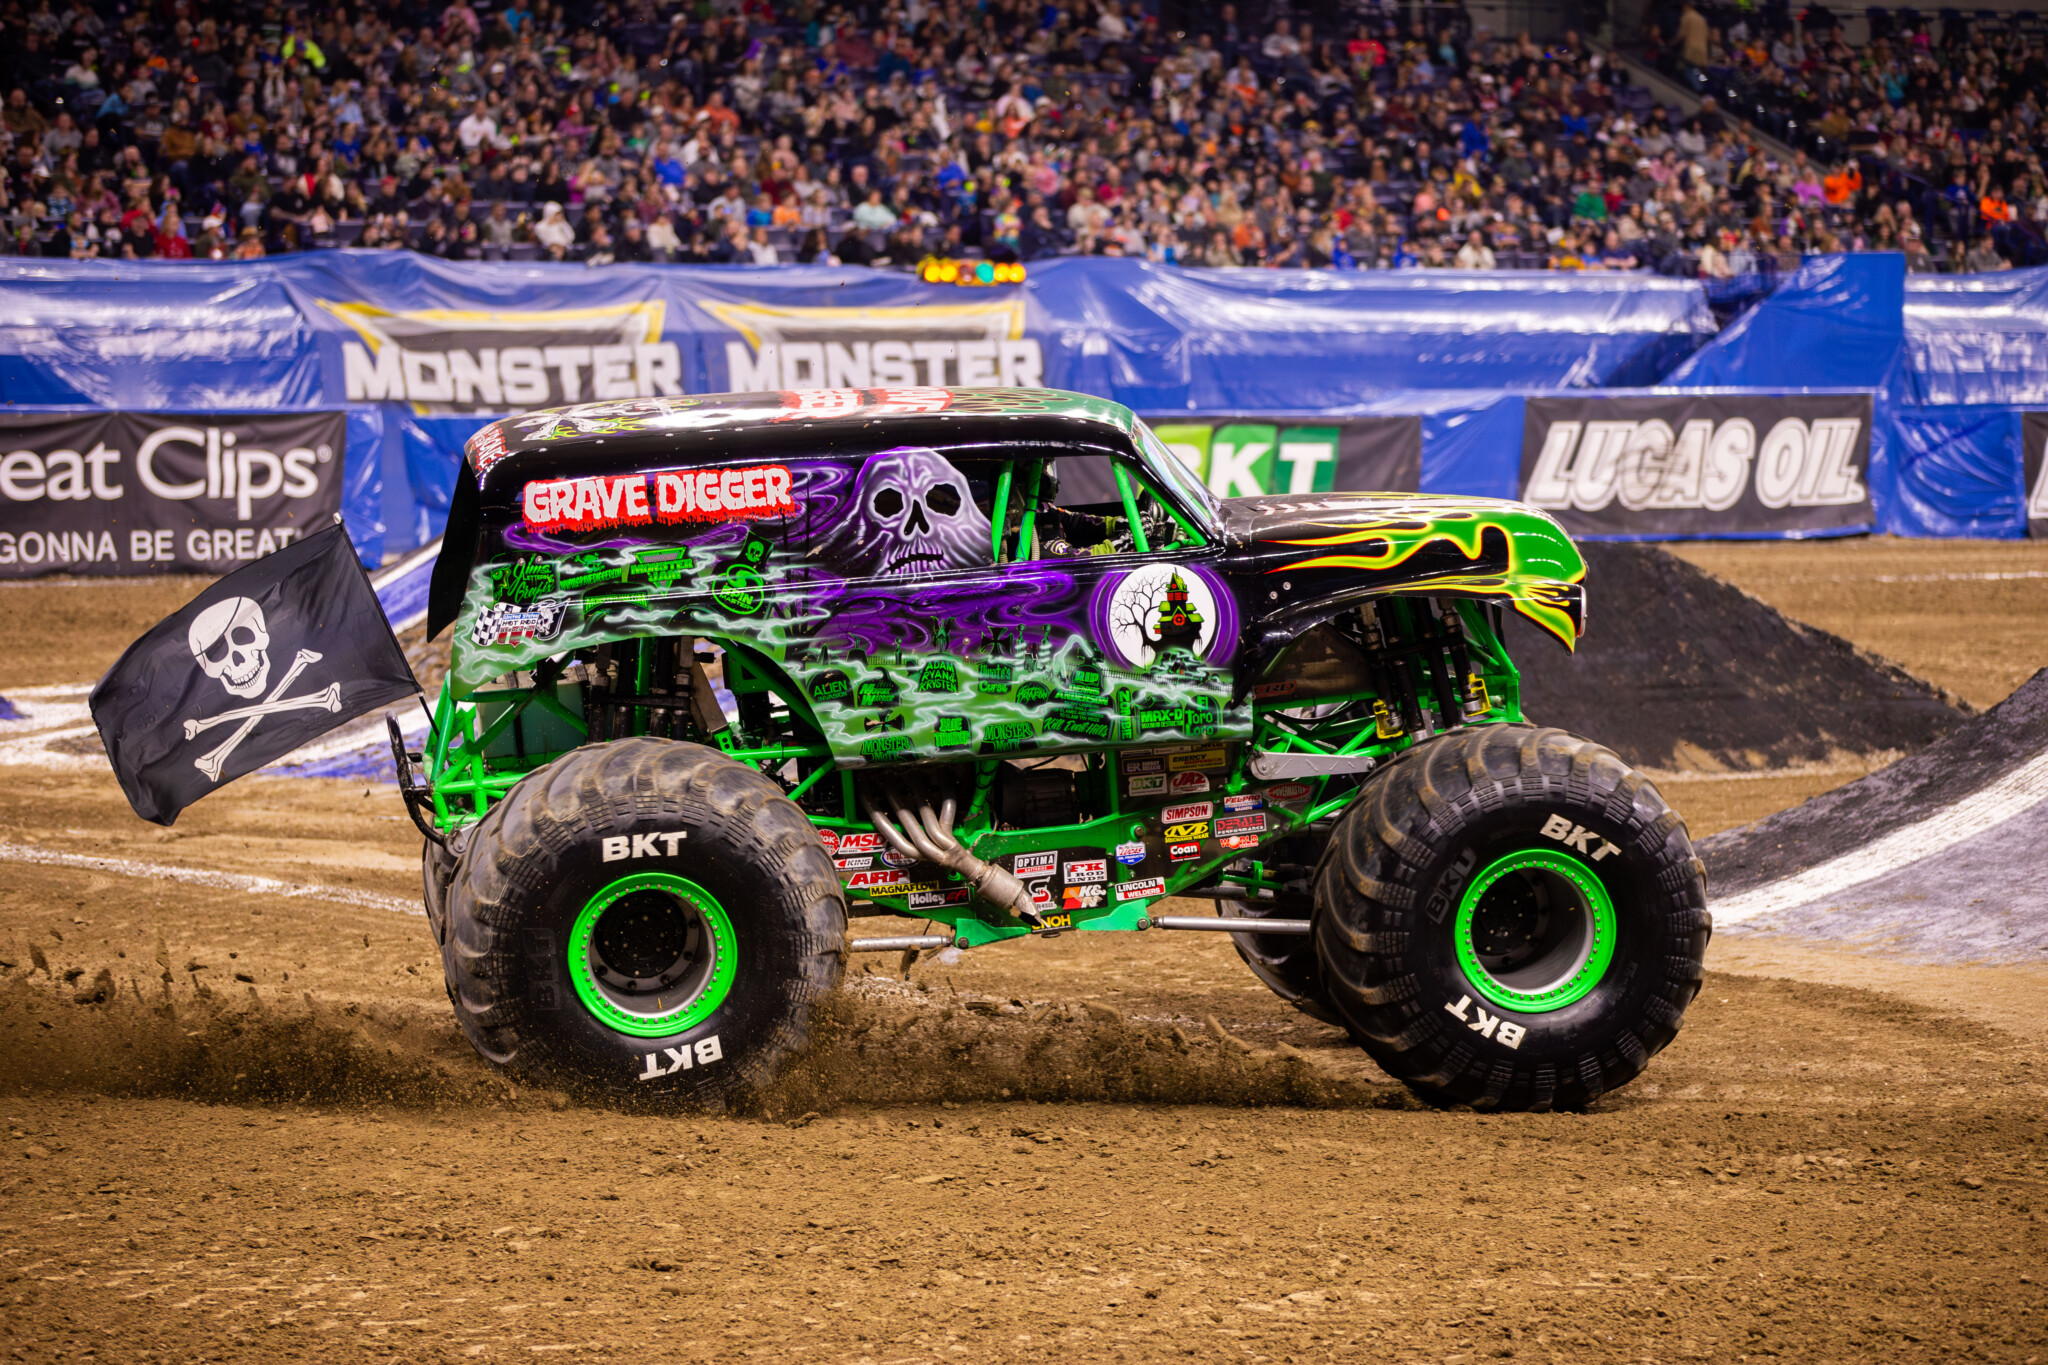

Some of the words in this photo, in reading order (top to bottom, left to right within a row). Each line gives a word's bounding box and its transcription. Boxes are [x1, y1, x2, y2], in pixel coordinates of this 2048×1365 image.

[726, 338, 1044, 389] MONSTER
[342, 341, 684, 404] MONSTER
[0, 441, 124, 501] eat
[1523, 417, 1756, 511] LUCAS
[1756, 417, 1862, 508] OIL
[524, 476, 648, 523] GRAVE
[657, 468, 792, 513] DIGGER
[130, 530, 175, 562] BE
[631, 558, 695, 575] MONSTER
[648, 570, 682, 583] JAM
[925, 660, 955, 672] ADAM
[921, 671, 949, 681] RYAN
[1074, 671, 1099, 682] RIP
[813, 680, 848, 697] ALIEN
[918, 679, 957, 692] KRYSTEN
[979, 680, 1009, 693] Curse
[818, 691, 847, 701] INVASION
[1118, 690, 1133, 740] ZOMBIE
[1140, 709, 1183, 722] MAX-D
[1185, 710, 1213, 726] Toro
[1043, 717, 1065, 730] Kill
[983, 724, 1034, 741] MONSTER
[863, 736, 911, 754] MONSTER
[1132, 777, 1163, 791] BKT
[1172, 772, 1206, 787] JAZ
[1166, 805, 1209, 820] SIMPSON
[1216, 815, 1264, 831] DERALE
[1217, 825, 1264, 835] PERFORMANCE
[842, 834, 887, 847] MSD
[1539, 813, 1622, 862] BKT
[602, 831, 687, 862] BKT
[1170, 845, 1198, 855] Coan
[847, 859, 871, 867] KING
[1018, 854, 1054, 868] OPTIMA
[1070, 862, 1104, 873] FK
[850, 870, 908, 886] ARP
[871, 881, 939, 895] MAGNAFLOW
[1117, 880, 1158, 893] LINCOLN
[1127, 888, 1161, 898] WELDERS
[910, 891, 946, 905] Holley
[1032, 913, 1071, 930] NOH
[1444, 994, 1527, 1050] BKT
[639, 1035, 723, 1081] BKT
